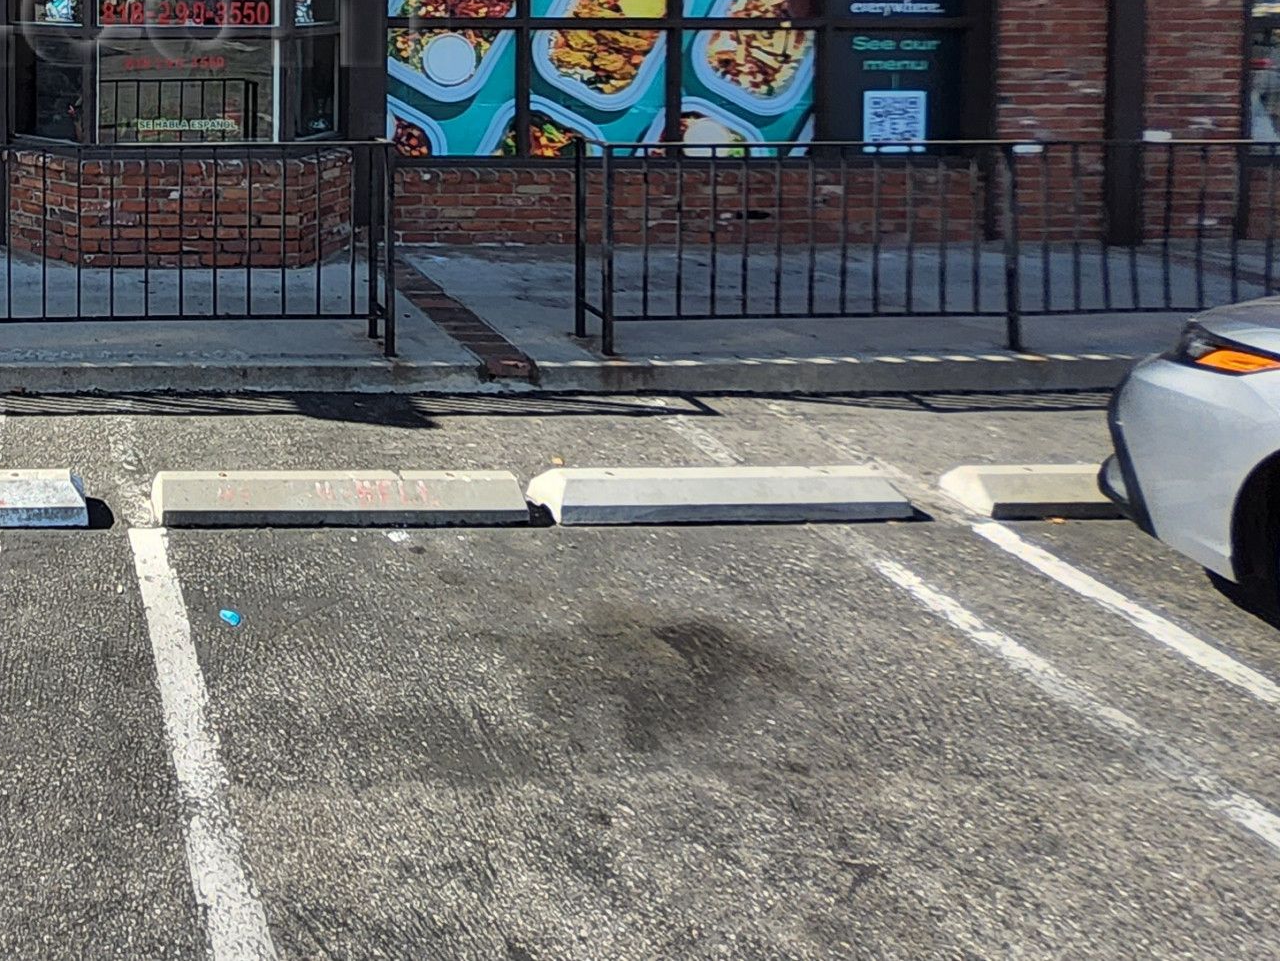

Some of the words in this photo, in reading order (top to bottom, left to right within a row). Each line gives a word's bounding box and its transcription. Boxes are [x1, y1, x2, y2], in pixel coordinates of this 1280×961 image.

[852, 36, 896, 50] See
[899, 39, 941, 50] our
[863, 60, 929, 70] menu
